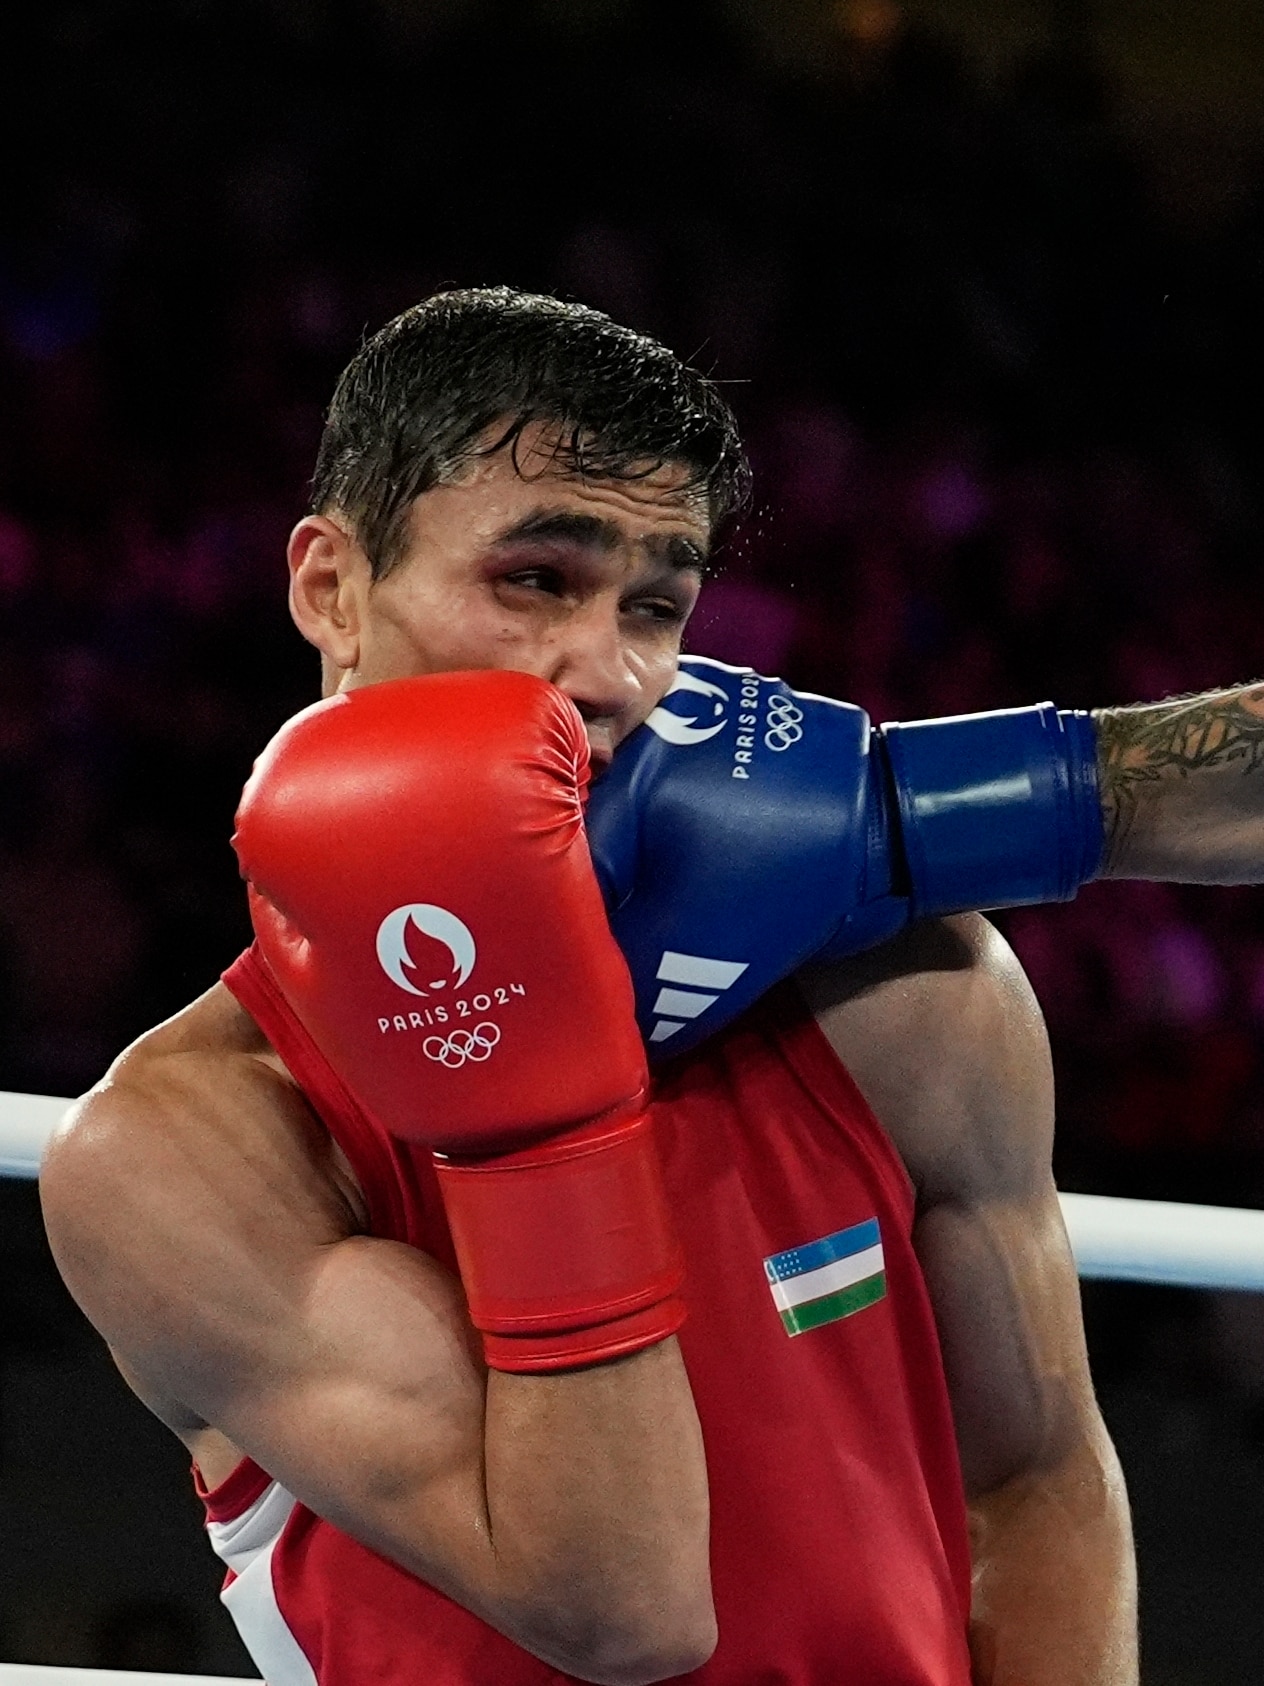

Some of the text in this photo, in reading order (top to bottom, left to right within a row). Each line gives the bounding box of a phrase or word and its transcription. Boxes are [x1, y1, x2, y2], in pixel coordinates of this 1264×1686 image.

[732, 713, 757, 779] PARIS
[377, 983, 526, 1034] PARIS 2024
